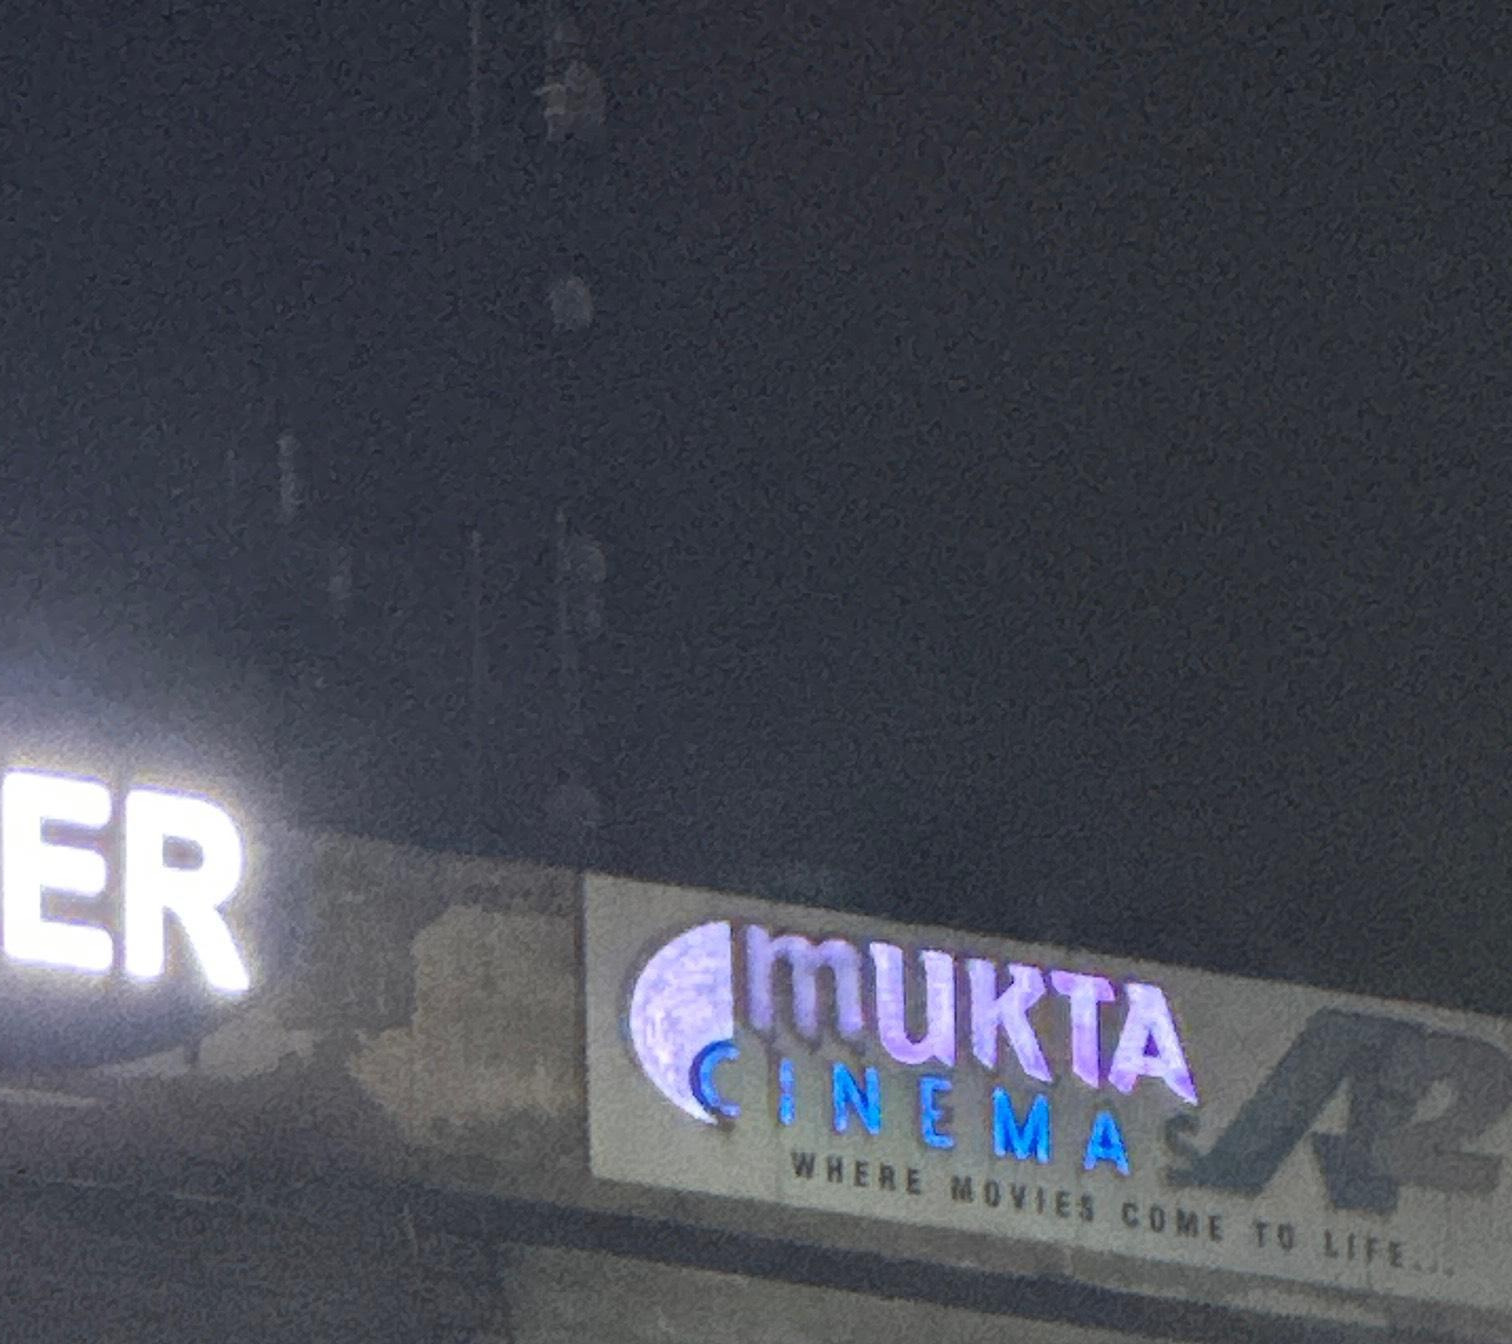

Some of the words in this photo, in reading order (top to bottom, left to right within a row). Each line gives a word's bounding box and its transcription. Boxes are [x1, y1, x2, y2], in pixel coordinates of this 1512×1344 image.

[790, 1151, 922, 1196] WHERE
[951, 1175, 1095, 1223] MOVIES
[1121, 1200, 1225, 1242] COME
[1253, 1220, 1294, 1252] TO
